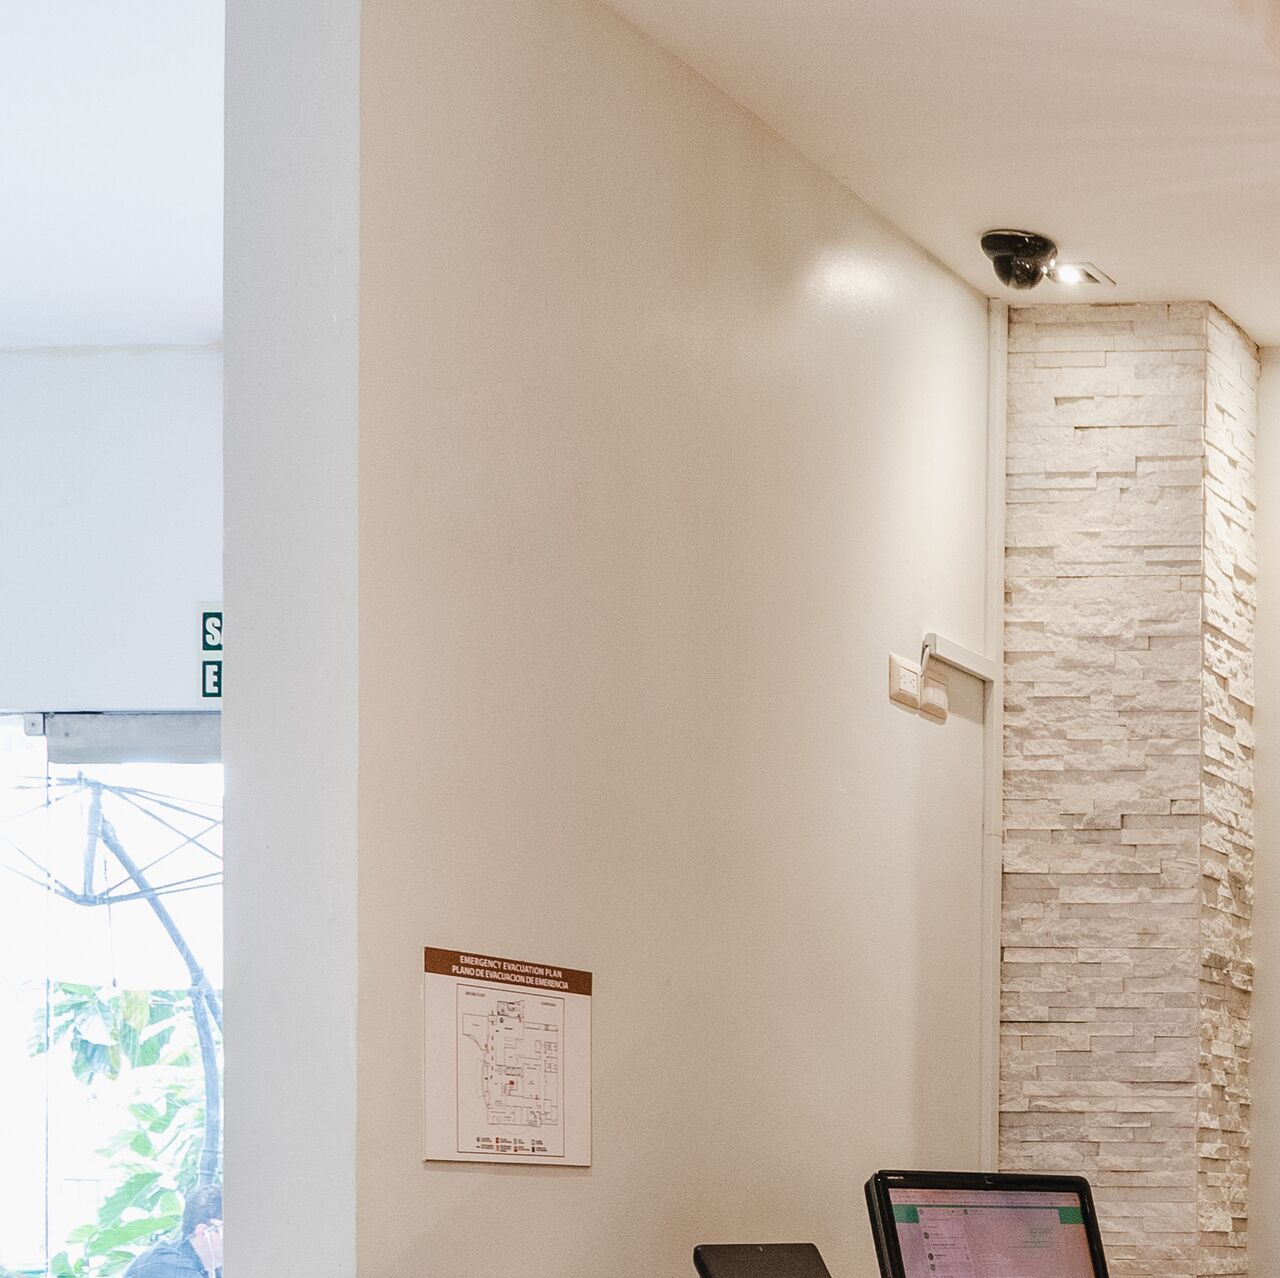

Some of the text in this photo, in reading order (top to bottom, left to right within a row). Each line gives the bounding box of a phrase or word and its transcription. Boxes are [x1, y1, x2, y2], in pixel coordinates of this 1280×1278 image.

[205, 616, 222, 646] S
[452, 965, 475, 976] PLANO
[476, 968, 485, 978] DE
[526, 976, 535, 985] DE
[460, 955, 562, 979] EMERGENCY EVACUATION PLAN
